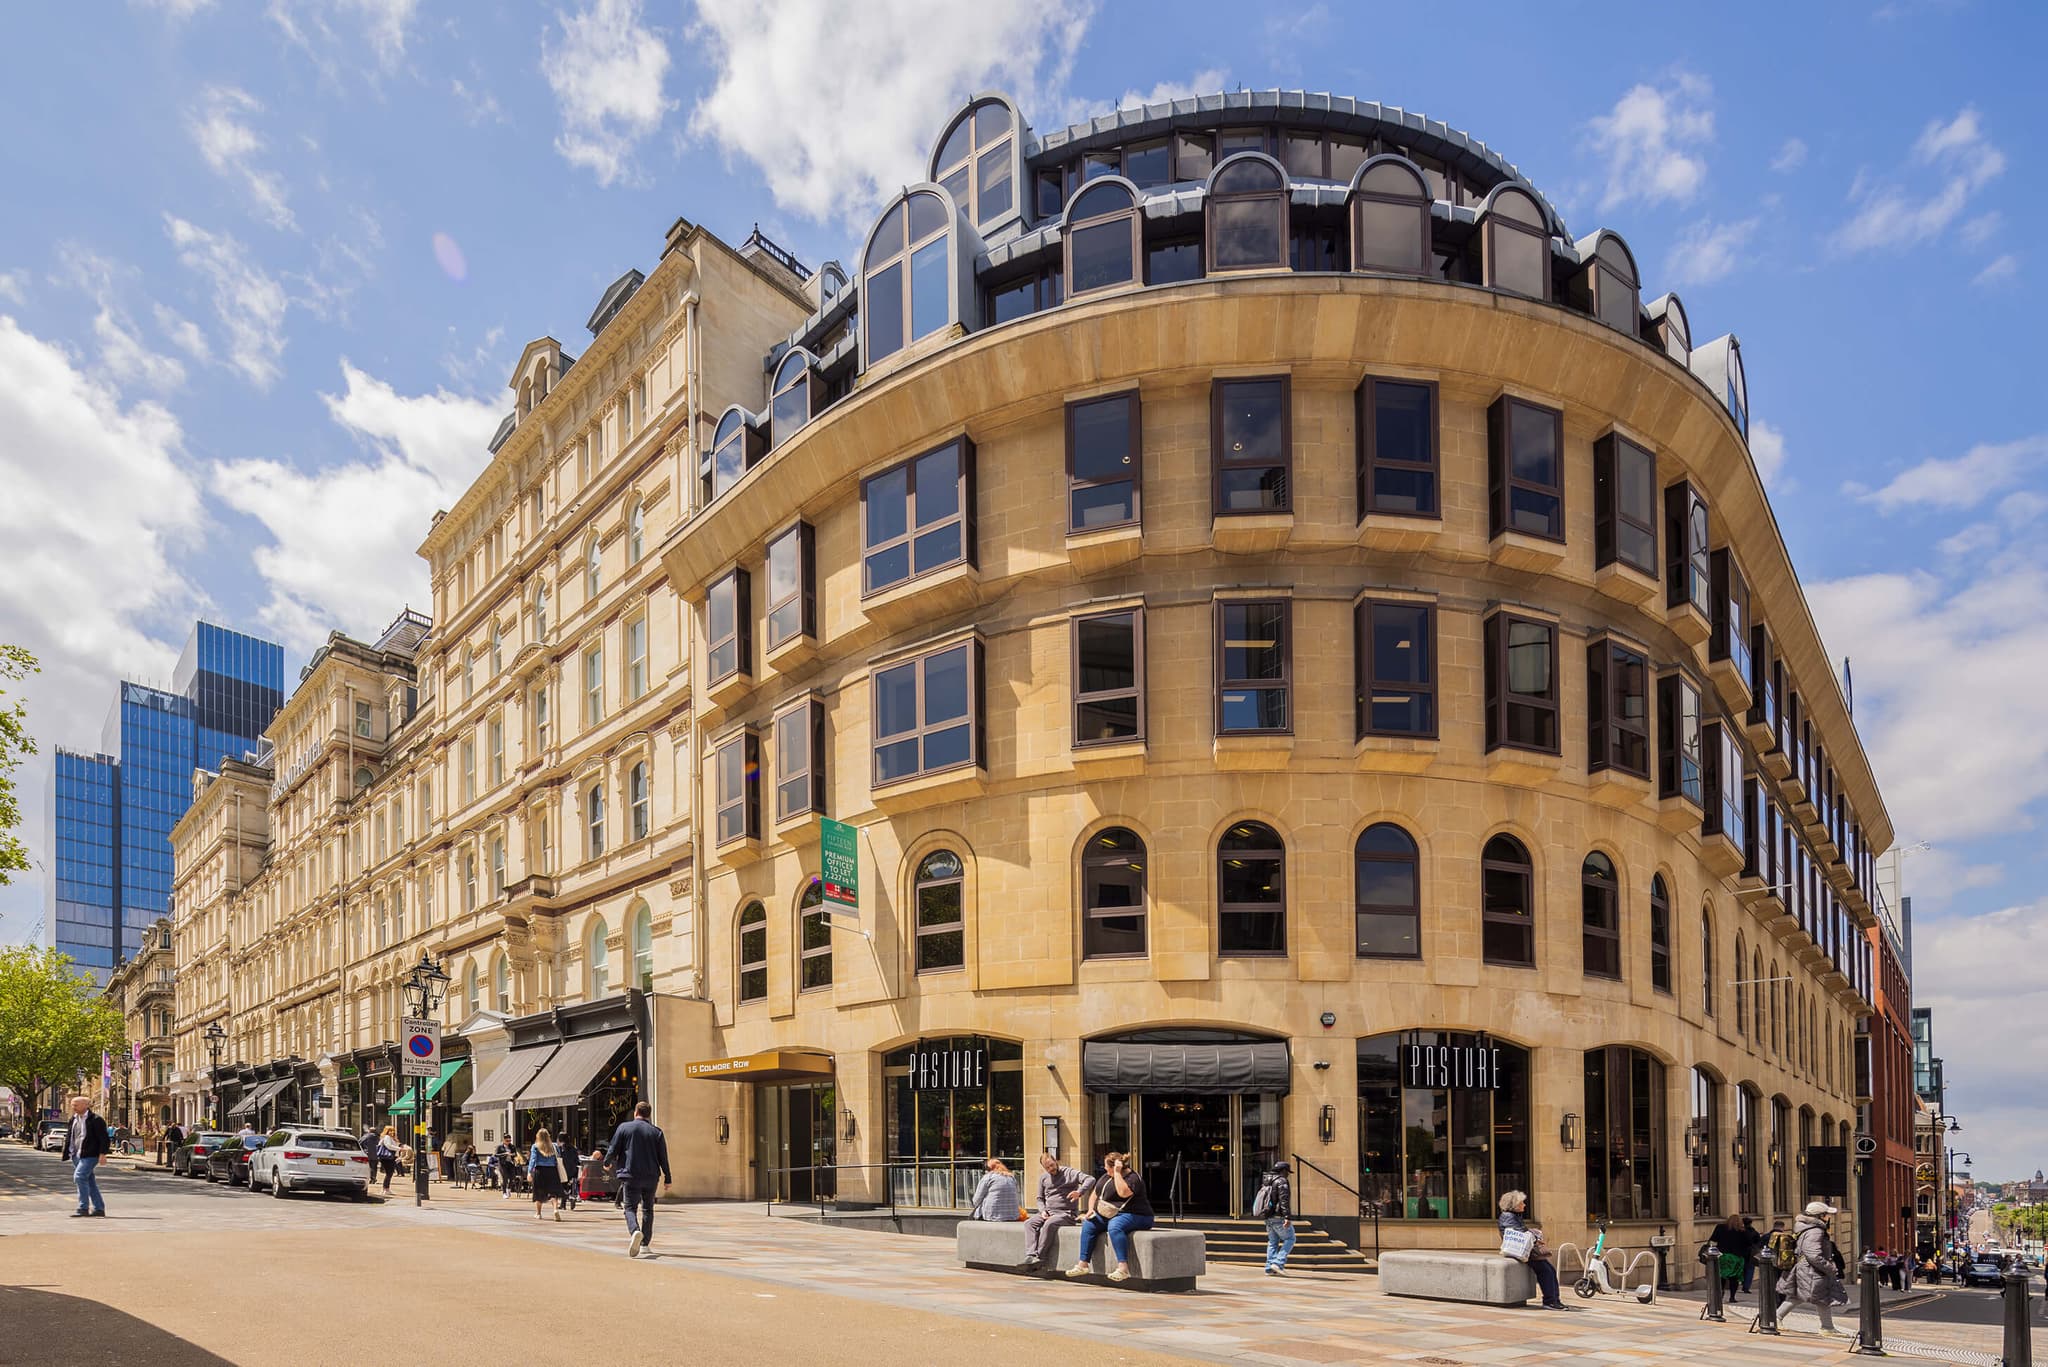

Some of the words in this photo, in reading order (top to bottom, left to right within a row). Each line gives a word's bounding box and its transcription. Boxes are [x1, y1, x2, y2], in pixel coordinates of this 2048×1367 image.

[824, 850, 854, 864] PREMIUM
[826, 858, 853, 871] OFFICES
[829, 865, 839, 873] TO
[840, 868, 851, 877] LET
[409, 1025, 433, 1034] ZONE
[415, 1058, 438, 1066] loading
[1410, 1045, 1501, 1089] PASTURE
[688, 1065, 697, 1074] 15
[908, 1049, 983, 1089] PASTURE
